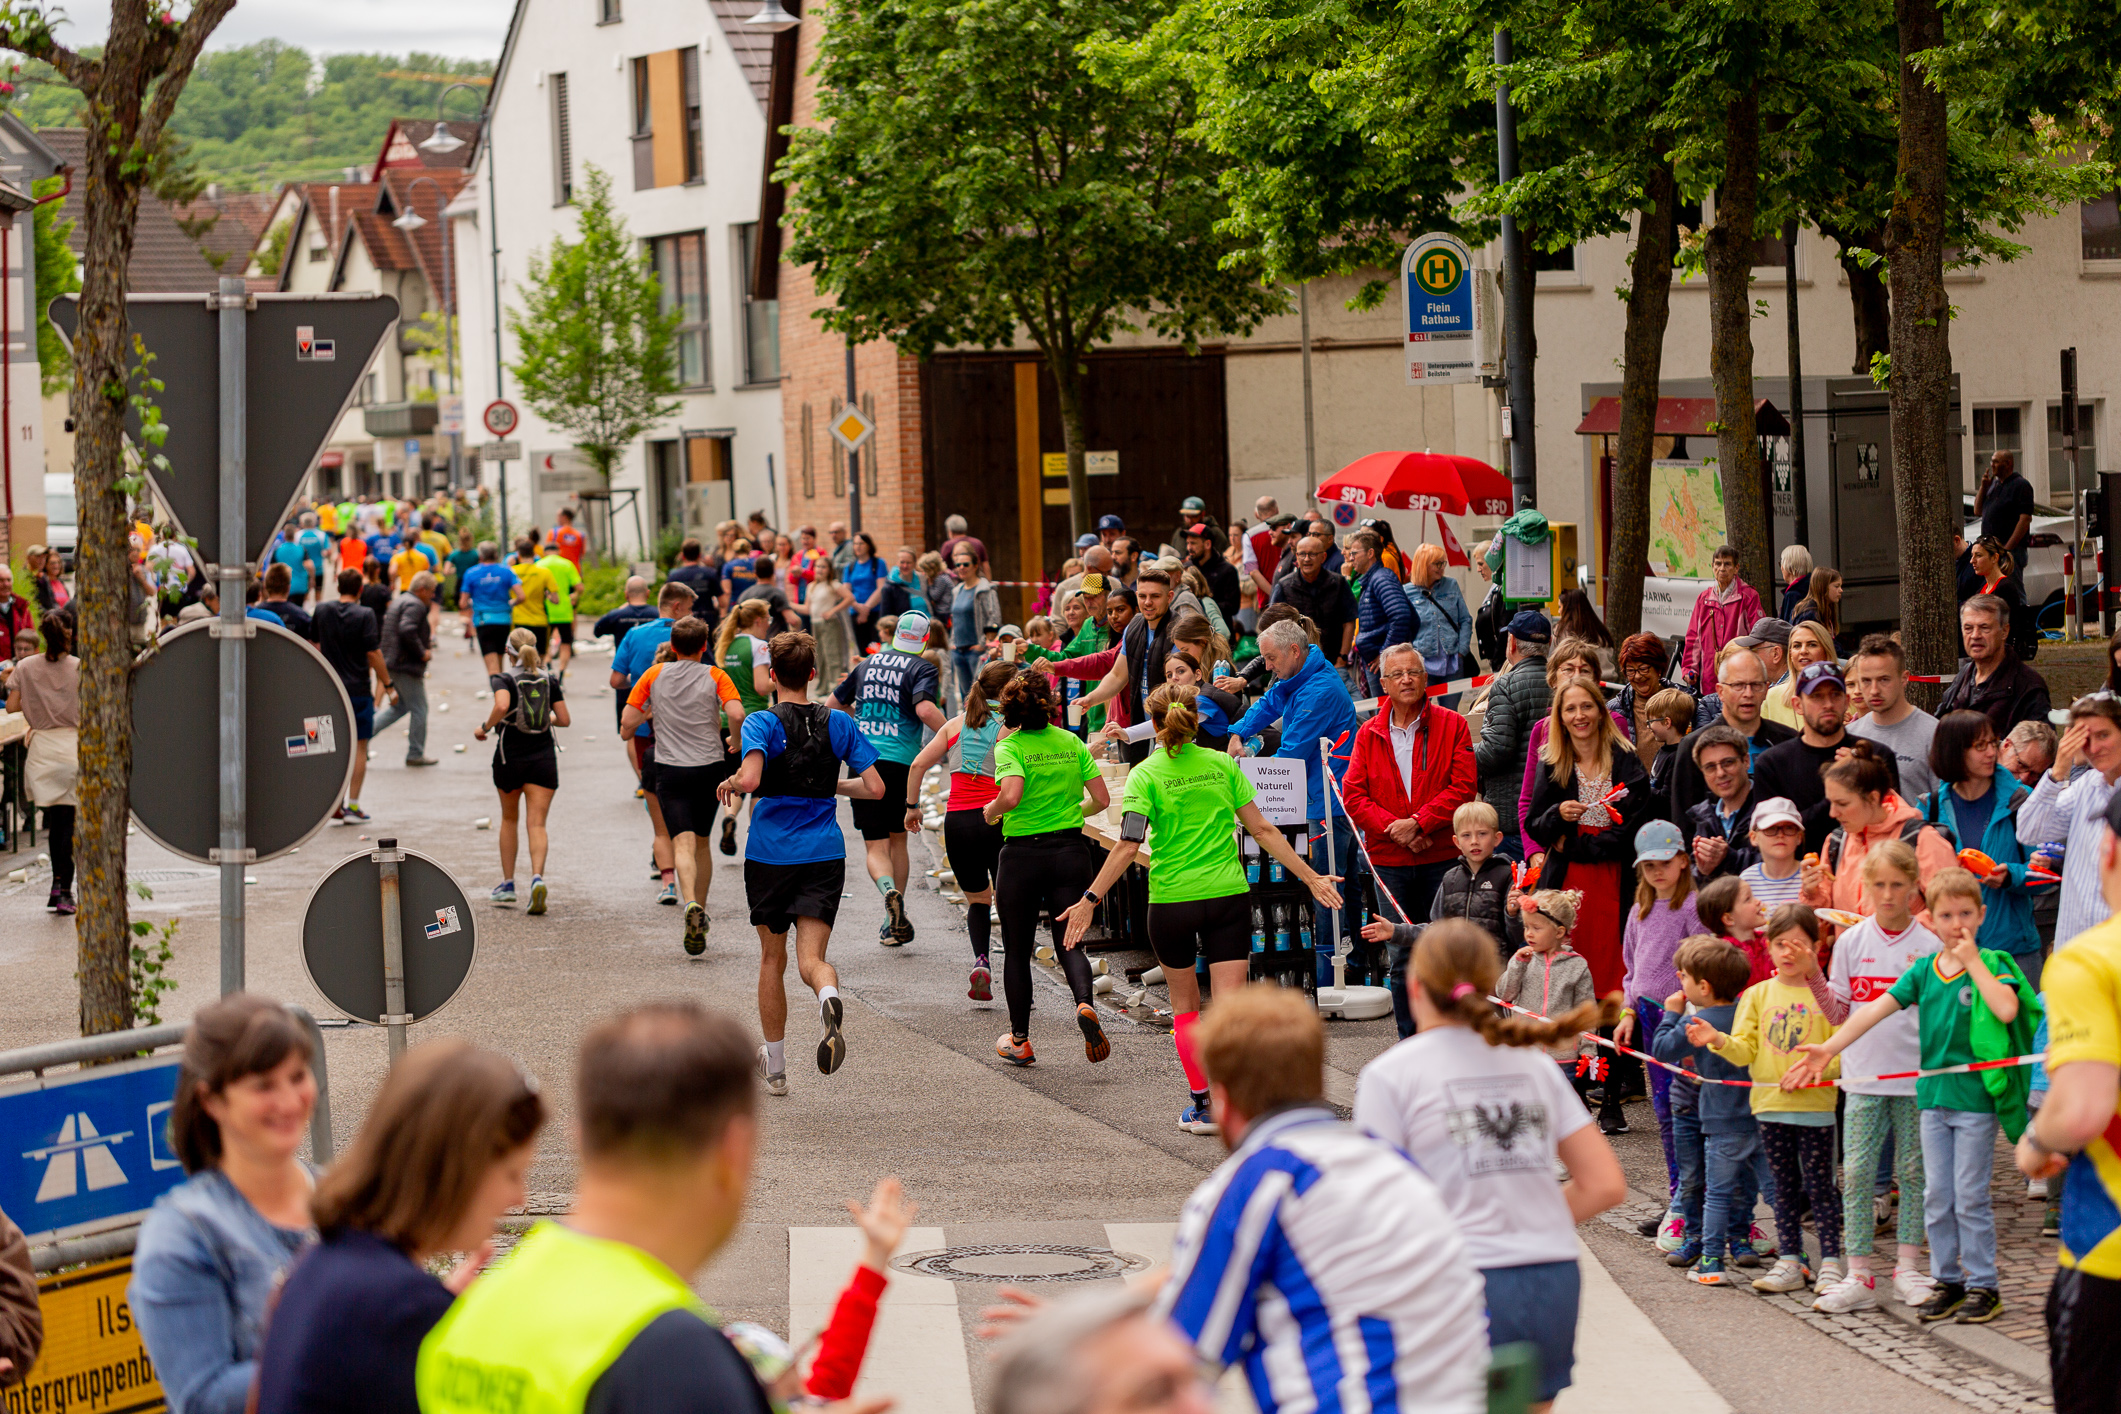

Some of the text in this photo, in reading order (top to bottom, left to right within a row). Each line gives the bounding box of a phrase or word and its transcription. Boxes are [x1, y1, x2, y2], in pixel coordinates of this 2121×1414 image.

[1429, 259, 1450, 284] H
[1427, 303, 1451, 312] Flein
[1421, 314, 1461, 325] Rathaus
[1427, 362, 1474, 370] Untergruppenbach
[490, 408, 512, 427] 30
[22, 424, 33, 440] 11
[1341, 486, 1367, 504] SPD
[1408, 494, 1442, 511] SPD
[1485, 499, 1508, 514] SPD
[869, 653, 912, 669] RUN
[864, 667, 904, 686] RUN
[862, 684, 900, 704] RUN
[861, 702, 900, 720] RUN
[859, 720, 899, 737] RUN
[1024, 751, 1077, 764] SPORT-einmalig.de
[1163, 771, 1225, 789] SPORT-einmalig.de
[1257, 767, 1291, 776] Wasser
[1256, 782, 1293, 791] Naturell
[1258, 806, 1298, 814] ohlensäure)
[97, 1295, 138, 1338] Ils
[0, 1345, 159, 1414] ntergruppenb
